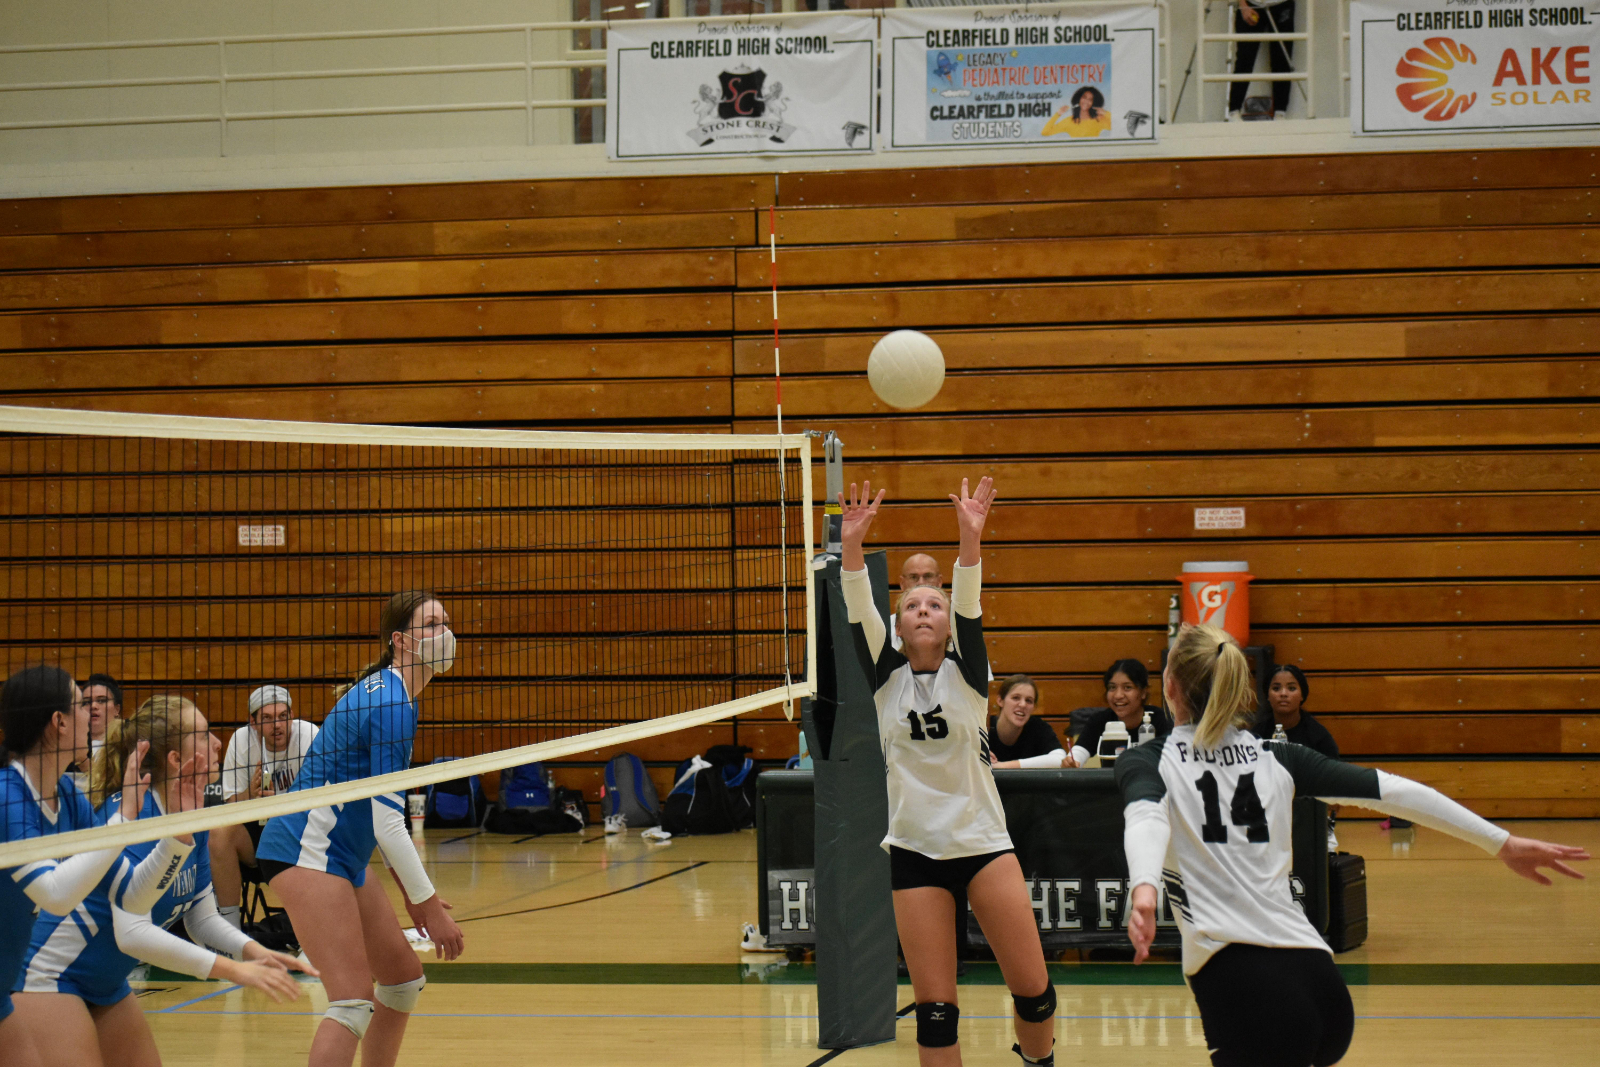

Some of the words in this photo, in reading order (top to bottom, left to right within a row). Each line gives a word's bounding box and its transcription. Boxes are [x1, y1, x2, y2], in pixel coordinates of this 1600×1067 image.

[974, 10, 1005, 23] Proud
[1009, 9, 1048, 23] Sponsor
[1396, 11, 1483, 31] CLEARFIELD
[1488, 9, 1523, 28] HIGH
[1529, 7, 1592, 27] SCHOOL.
[697, 21, 728, 35] Proud
[732, 21, 770, 35] Sponsor
[926, 29, 1009, 48] CLEARFIELD
[1014, 27, 1049, 46] HIGH
[1054, 25, 1115, 44] SCHOOL.
[650, 39, 732, 59] CLEARFIELD
[737, 37, 770, 56] HIGH
[775, 36, 835, 55] SCHOOL.
[967, 53, 1007, 67] LEGACY
[1492, 46, 1590, 87] AKE
[963, 66, 1030, 87] PEDIATRIC
[1033, 64, 1105, 85] DENTISTRY
[1016, 91, 1025, 99] to
[1027, 90, 1062, 103] support
[1491, 89, 1591, 106] SOLAR
[930, 104, 1015, 120] CLEARFIELD
[1018, 102, 1052, 118] HIGH
[701, 120, 742, 134] STONE
[746, 120, 783, 133] CREST
[952, 121, 1022, 139] STUDENTS
[1201, 585, 1222, 608] G
[907, 704, 949, 740] 15
[1195, 770, 1270, 843] 14
[156, 855, 182, 890] WOLFPACK
[1024, 880, 1082, 931] HE
